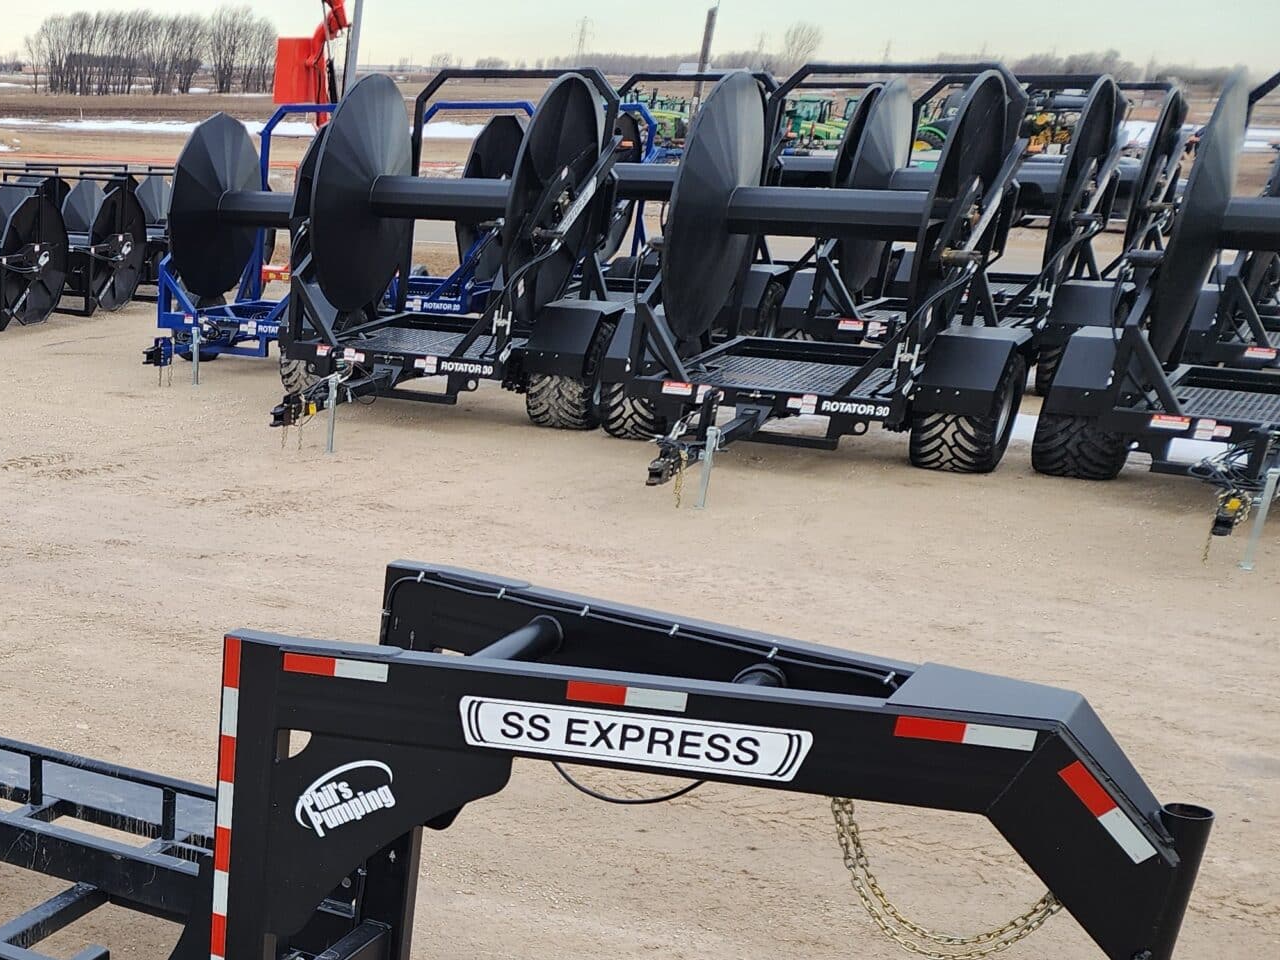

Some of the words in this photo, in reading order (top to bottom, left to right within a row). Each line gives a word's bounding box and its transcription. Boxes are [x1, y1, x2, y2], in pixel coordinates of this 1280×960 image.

[423, 302, 452, 311] ROTATOR
[440, 361, 482, 375] ROTATOR
[821, 400, 875, 415] ROTATOR
[875, 405, 890, 417] 30
[500, 711, 551, 742] SS
[564, 718, 760, 766] EXPRESS
[299, 781, 354, 812] Phil's
[308, 785, 396, 837] Pumping
